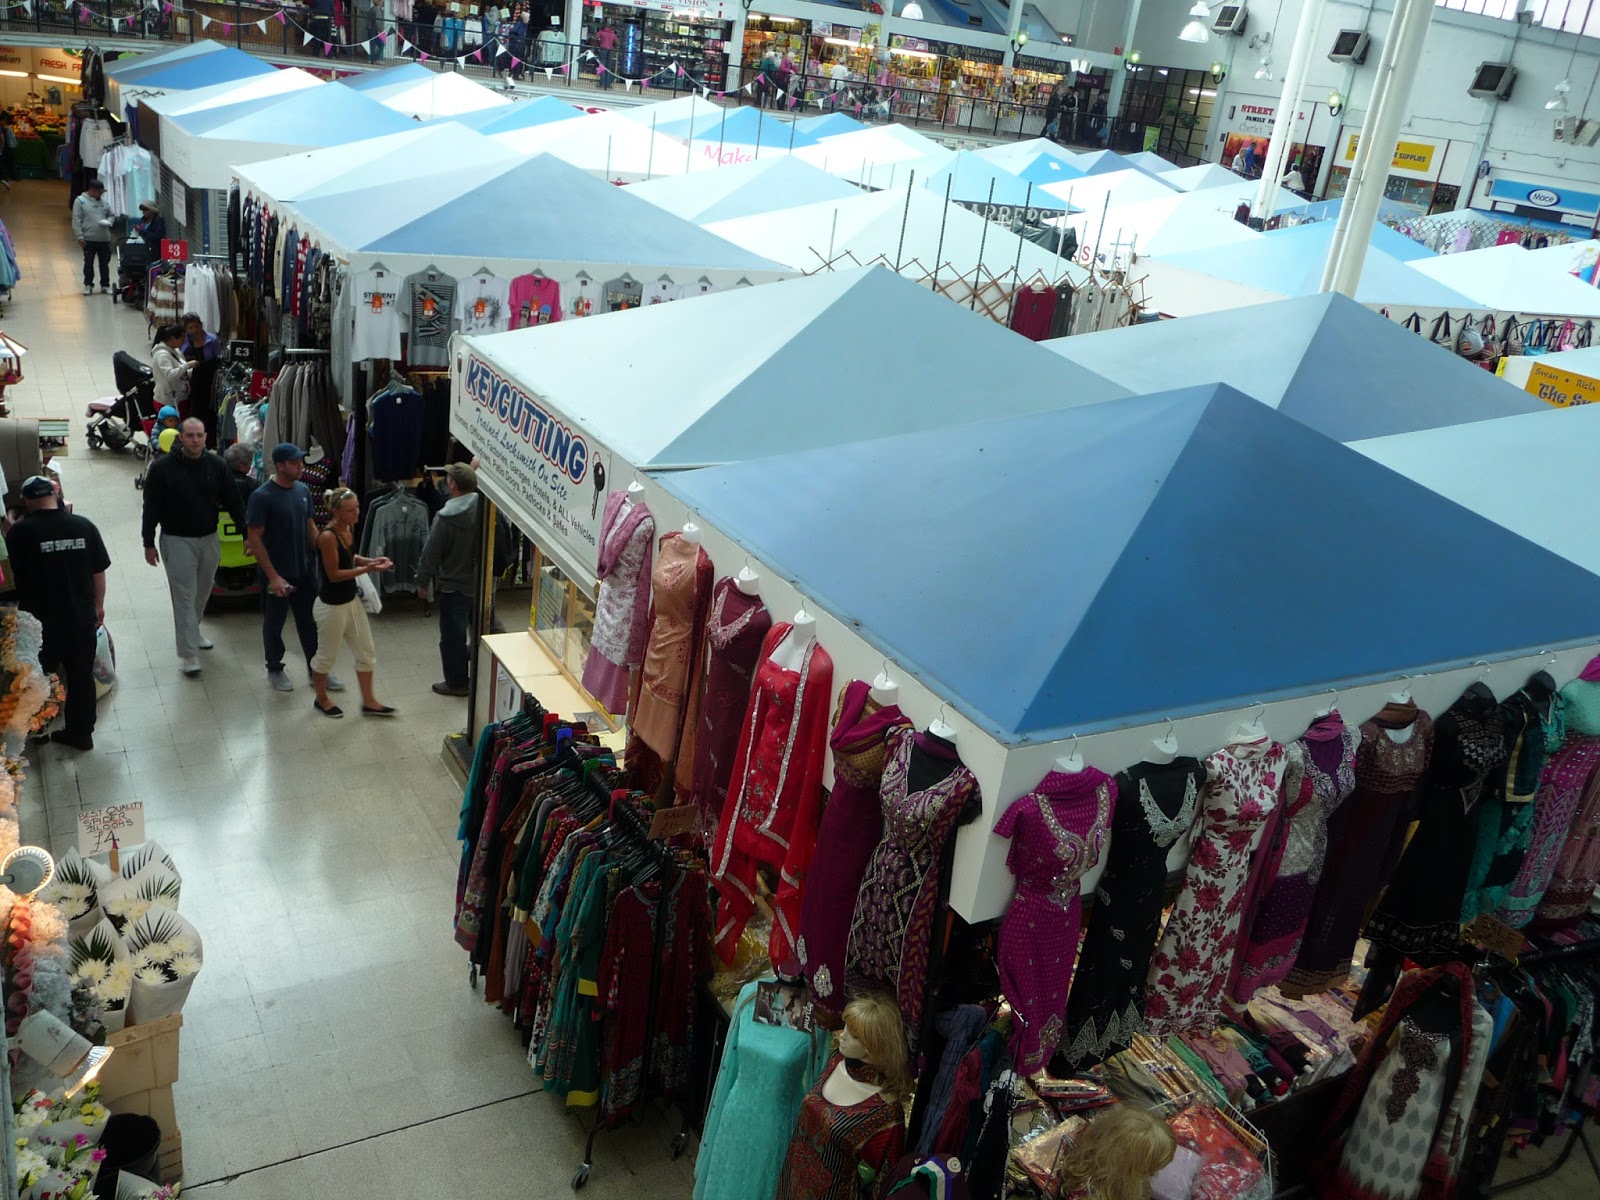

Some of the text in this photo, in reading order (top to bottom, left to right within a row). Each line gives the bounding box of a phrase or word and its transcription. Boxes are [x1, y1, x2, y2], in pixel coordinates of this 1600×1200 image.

[40, 58, 67, 70] FRESH
[1241, 104, 1275, 116] STREET
[1246, 115, 1266, 123] FAMILY
[1399, 152, 1426, 163] SUPPLIES
[1532, 192, 1554, 203] Mace
[168, 244, 181, 258] £3
[235, 347, 250, 357] £3
[1535, 368, 1597, 392] Swan Rizla
[1538, 383, 1567, 404] The
[465, 354, 588, 484] KEYCUTTING
[476, 407, 568, 501] Trained Locksmith On Site
[493, 459, 505, 477] Patio
[522, 486, 546, 515] Padlocks
[553, 514, 568, 536] Safes
[510, 460, 532, 489] Garages,
[533, 480, 551, 507] Hotels,
[558, 504, 570, 522] ALL
[571, 514, 595, 546] Vehicles
[40, 538, 86, 552] PET SUPPLIES
[79, 801, 143, 820] BEST QUALITY
[83, 812, 127, 826] SPIDER
[86, 819, 134, 833] BLOOMS
[90, 830, 120, 854] £4
